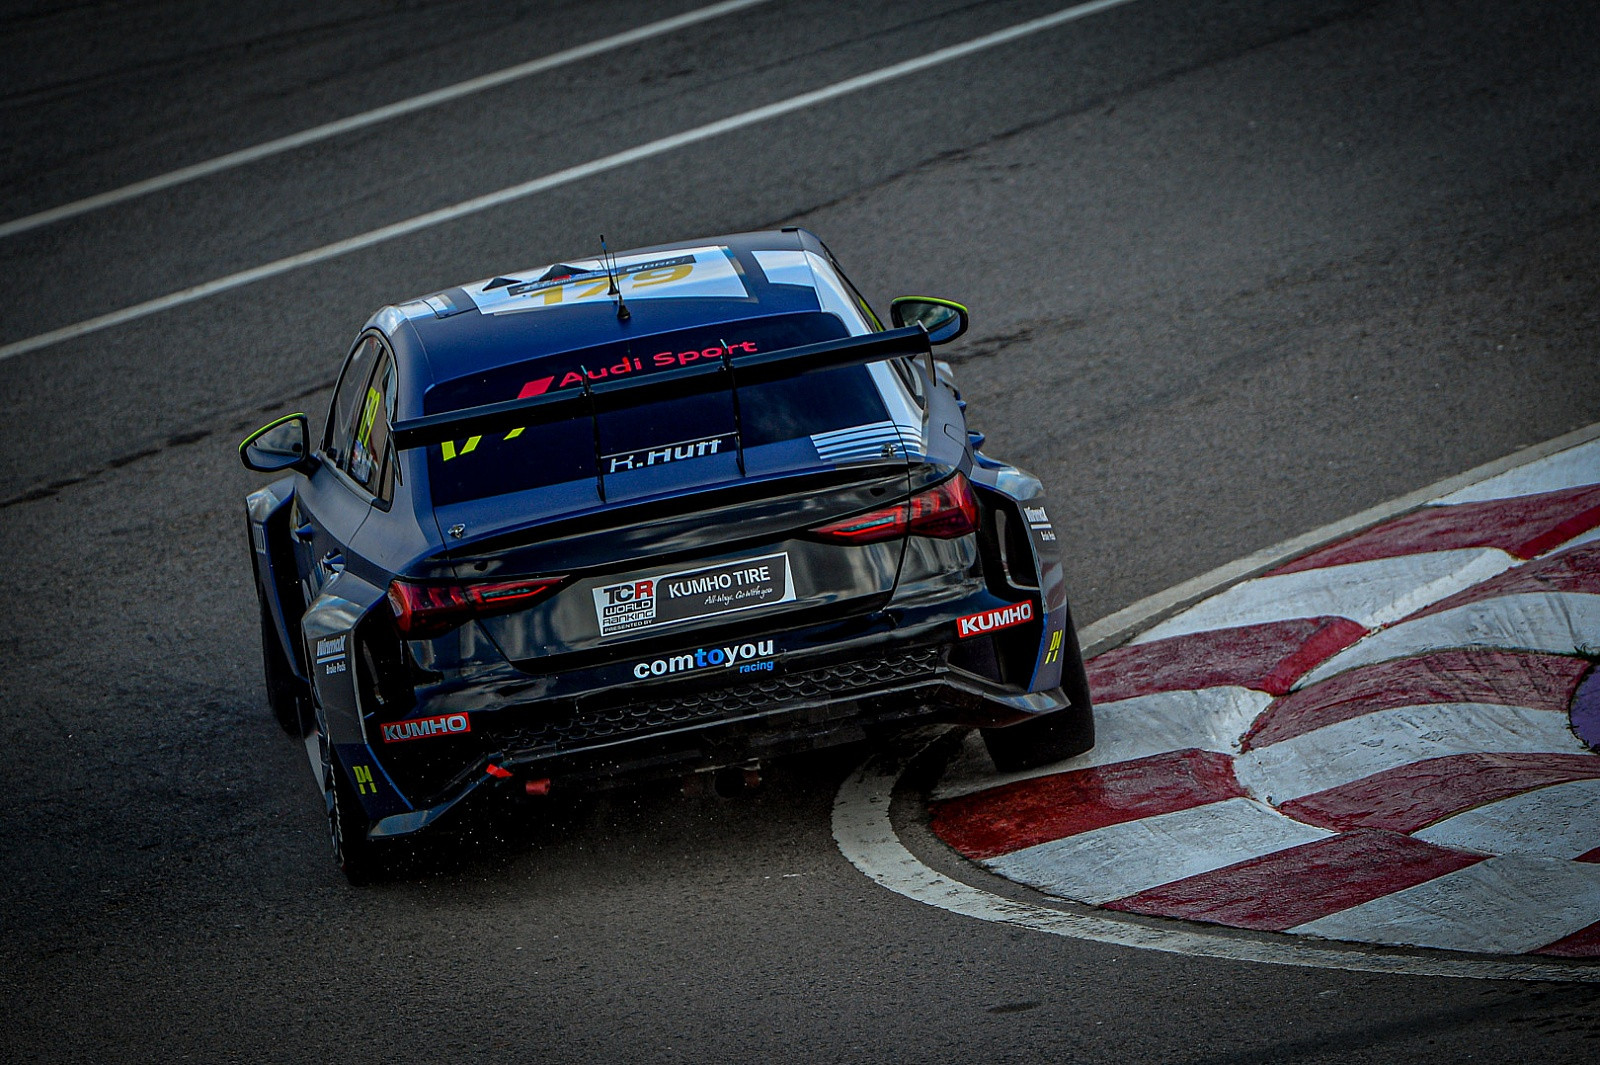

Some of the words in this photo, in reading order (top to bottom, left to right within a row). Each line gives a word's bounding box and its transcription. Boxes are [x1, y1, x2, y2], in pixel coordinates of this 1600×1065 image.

[530, 264, 693, 305] 179
[559, 357, 643, 387] Audi
[653, 341, 758, 366] Sport
[603, 580, 654, 604] TCR
[668, 574, 732, 599] KUMHO
[733, 566, 771, 586] TIRE
[605, 601, 651, 615] WORLD
[961, 603, 1031, 634] KUMHO
[604, 621, 643, 632] PRESENTED
[633, 640, 774, 679] comtoyou
[739, 660, 774, 674] racing
[383, 715, 467, 741] KUMHO
